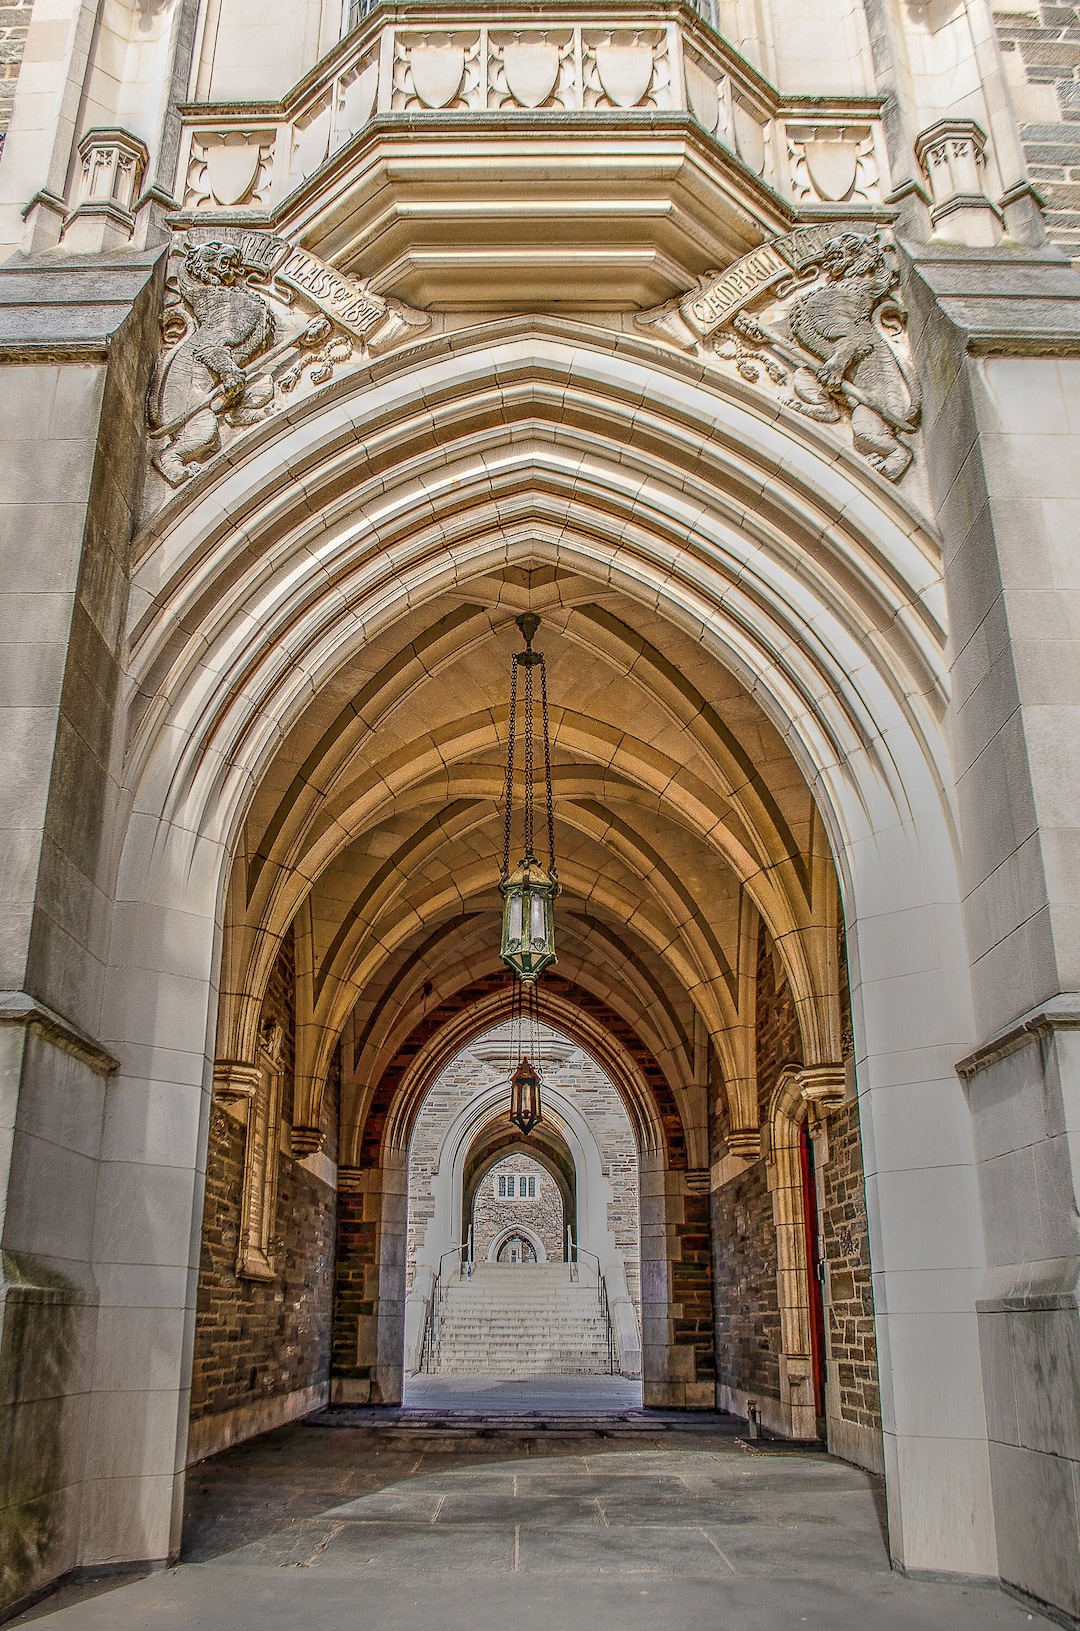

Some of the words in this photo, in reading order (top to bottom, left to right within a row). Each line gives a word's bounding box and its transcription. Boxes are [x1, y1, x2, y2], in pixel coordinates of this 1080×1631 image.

[241, 233, 285, 266] THE
[283, 253, 341, 299] CLASS
[692, 249, 785, 323] CAMPBELL
[333, 287, 352, 303] OF
[334, 298, 380, 332] 1877
